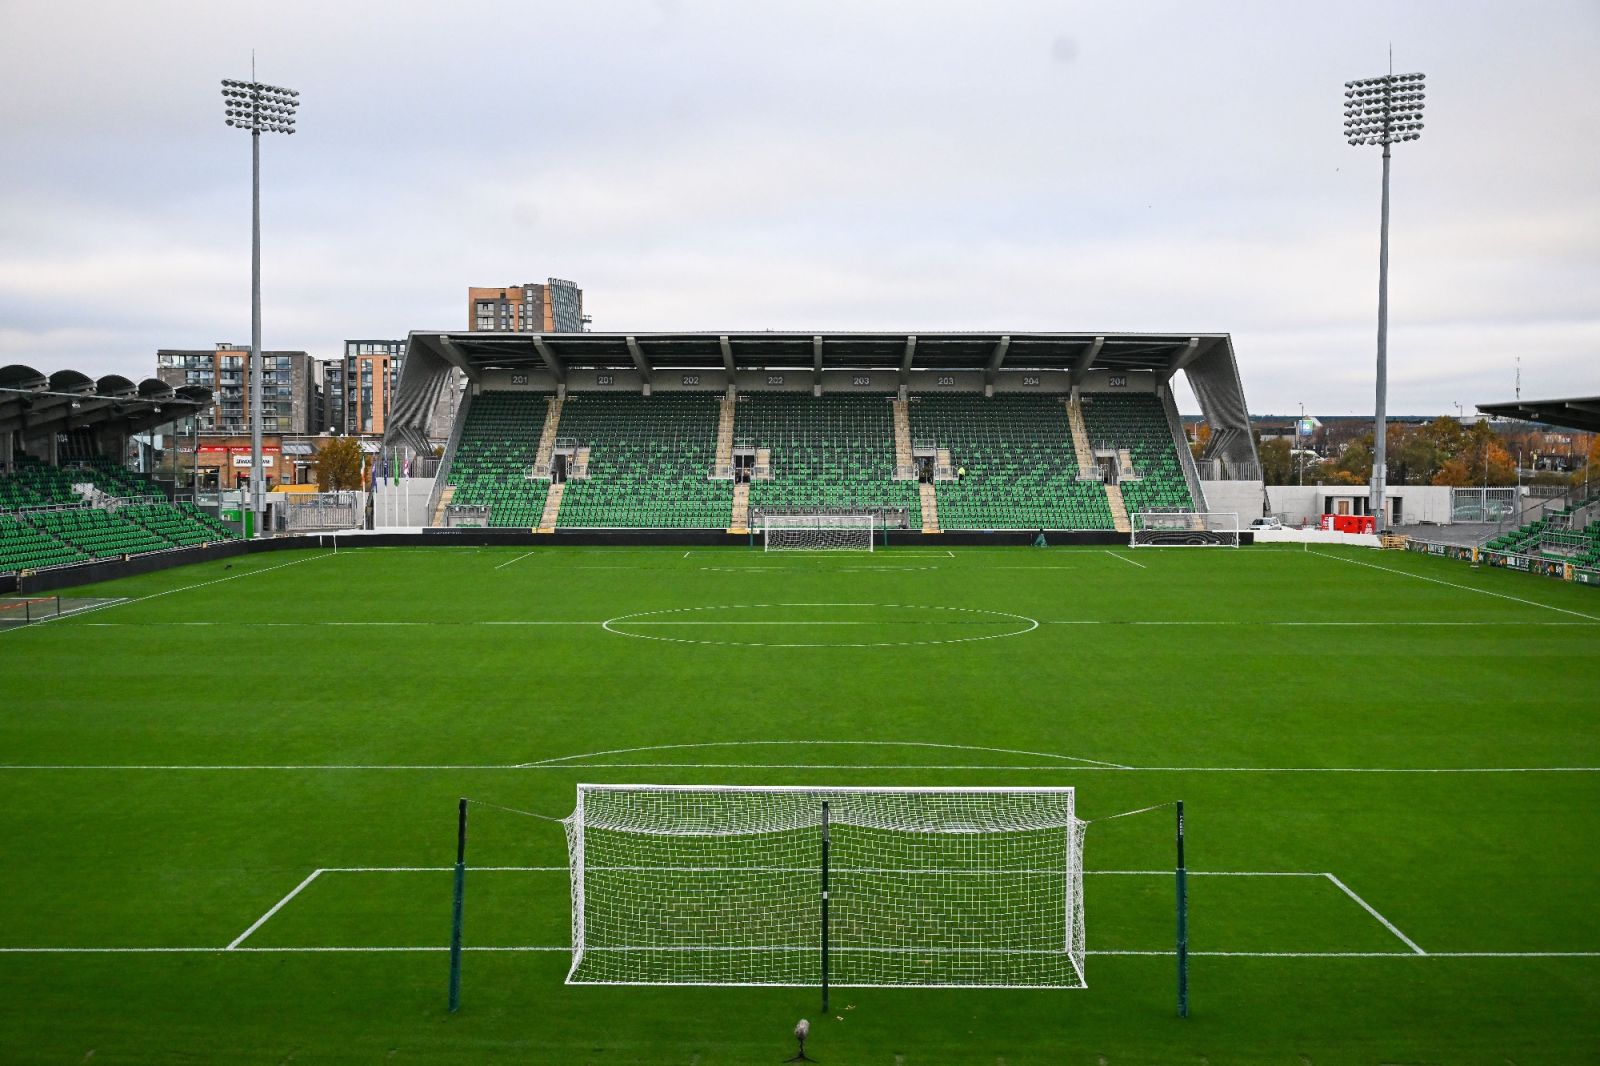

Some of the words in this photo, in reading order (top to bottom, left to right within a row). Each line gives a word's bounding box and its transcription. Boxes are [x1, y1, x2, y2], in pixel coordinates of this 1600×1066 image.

[512, 376, 528, 384] 201
[598, 376, 613, 384] 201
[683, 377, 699, 385] 202
[768, 376, 783, 384] 202
[853, 377, 870, 385] 203
[938, 377, 954, 385] 203
[1023, 377, 1039, 385] 204
[1109, 378, 1125, 386] 204
